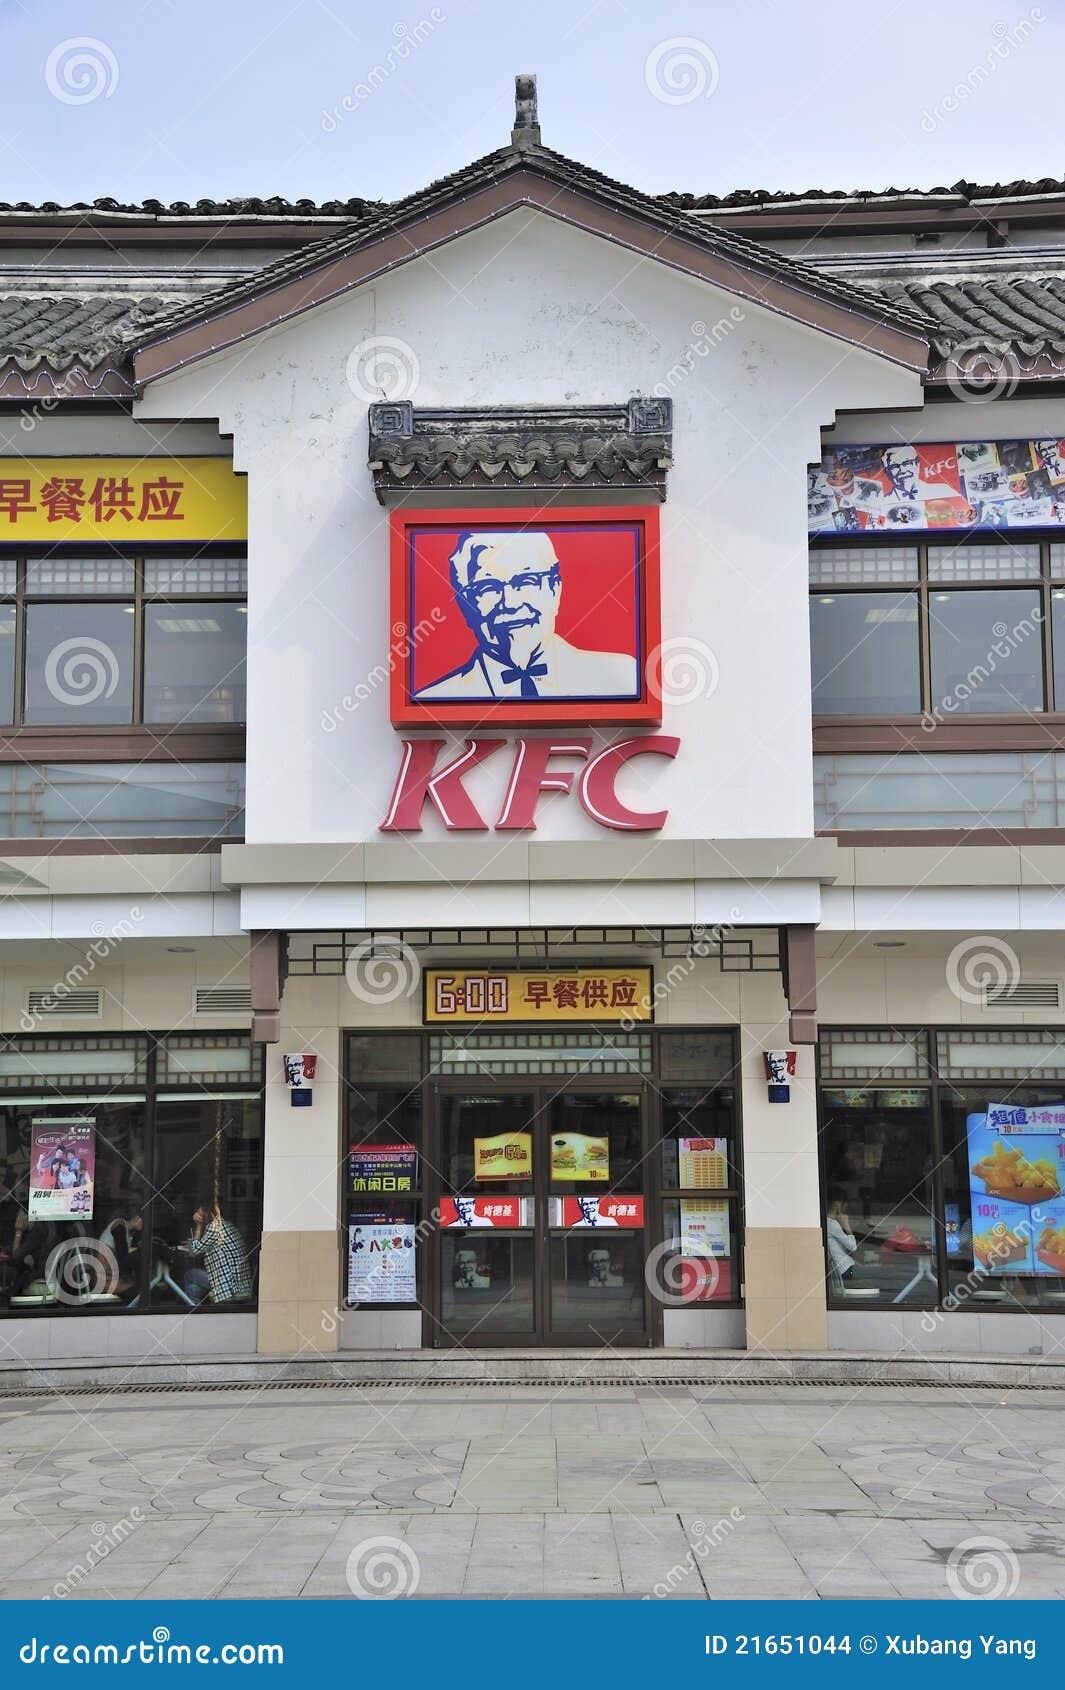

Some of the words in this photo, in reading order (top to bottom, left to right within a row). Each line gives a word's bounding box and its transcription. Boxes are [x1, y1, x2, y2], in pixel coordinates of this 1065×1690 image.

[923, 457, 956, 478] KFC
[0, 476, 185, 523] 早餐供应
[378, 735, 681, 832] KFC
[434, 976, 509, 1014] 6:00
[523, 977, 639, 1009] 早餐供应
[353, 1176, 411, 1191] 休闲日房
[483, 1205, 512, 1217] 肯德基
[607, 1204, 637, 1217] 肯德基
